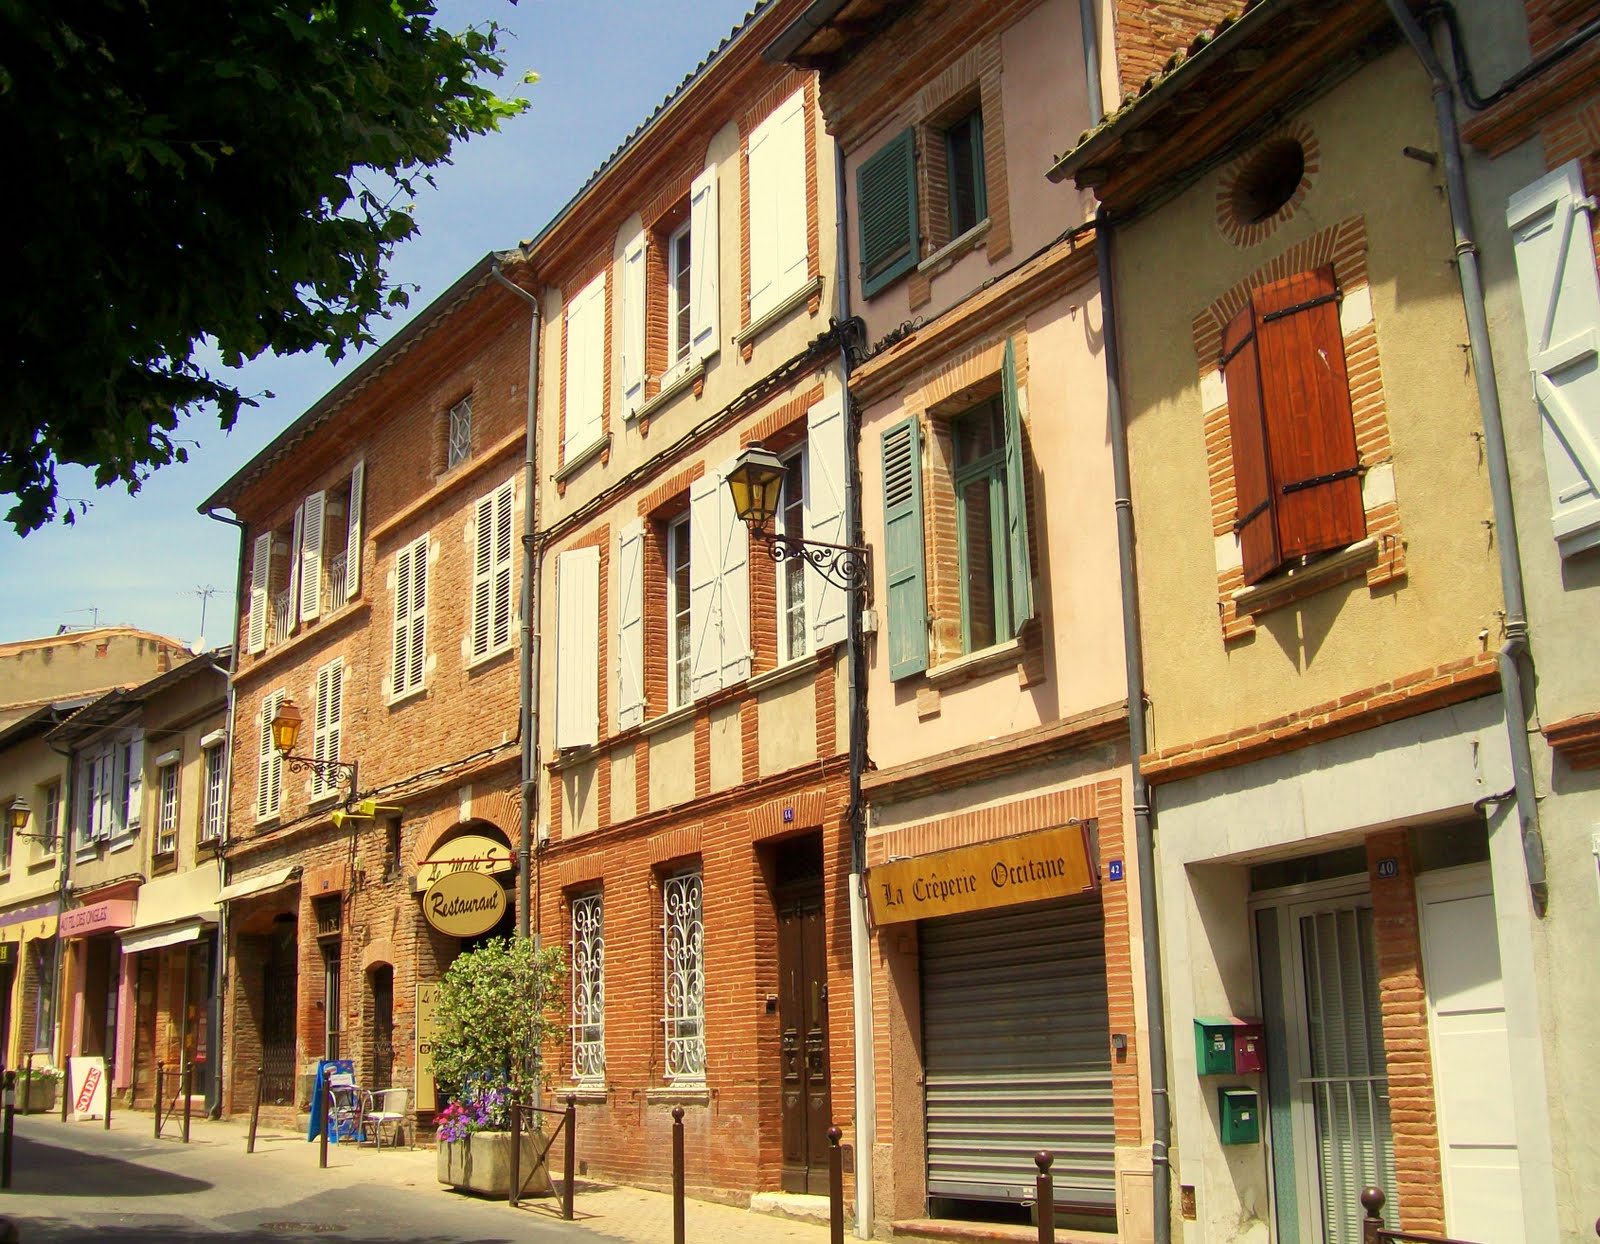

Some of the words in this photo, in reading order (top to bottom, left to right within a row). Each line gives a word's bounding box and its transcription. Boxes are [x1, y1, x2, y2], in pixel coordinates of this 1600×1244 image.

[881, 883, 905, 907] La
[912, 869, 977, 902] Crêperie
[991, 856, 1065, 888] Occitane
[1110, 864, 1120, 875] 42
[1379, 861, 1394, 875] 40
[430, 890, 499, 919] Restaurant
[77, 1068, 100, 1112] SOLDES
